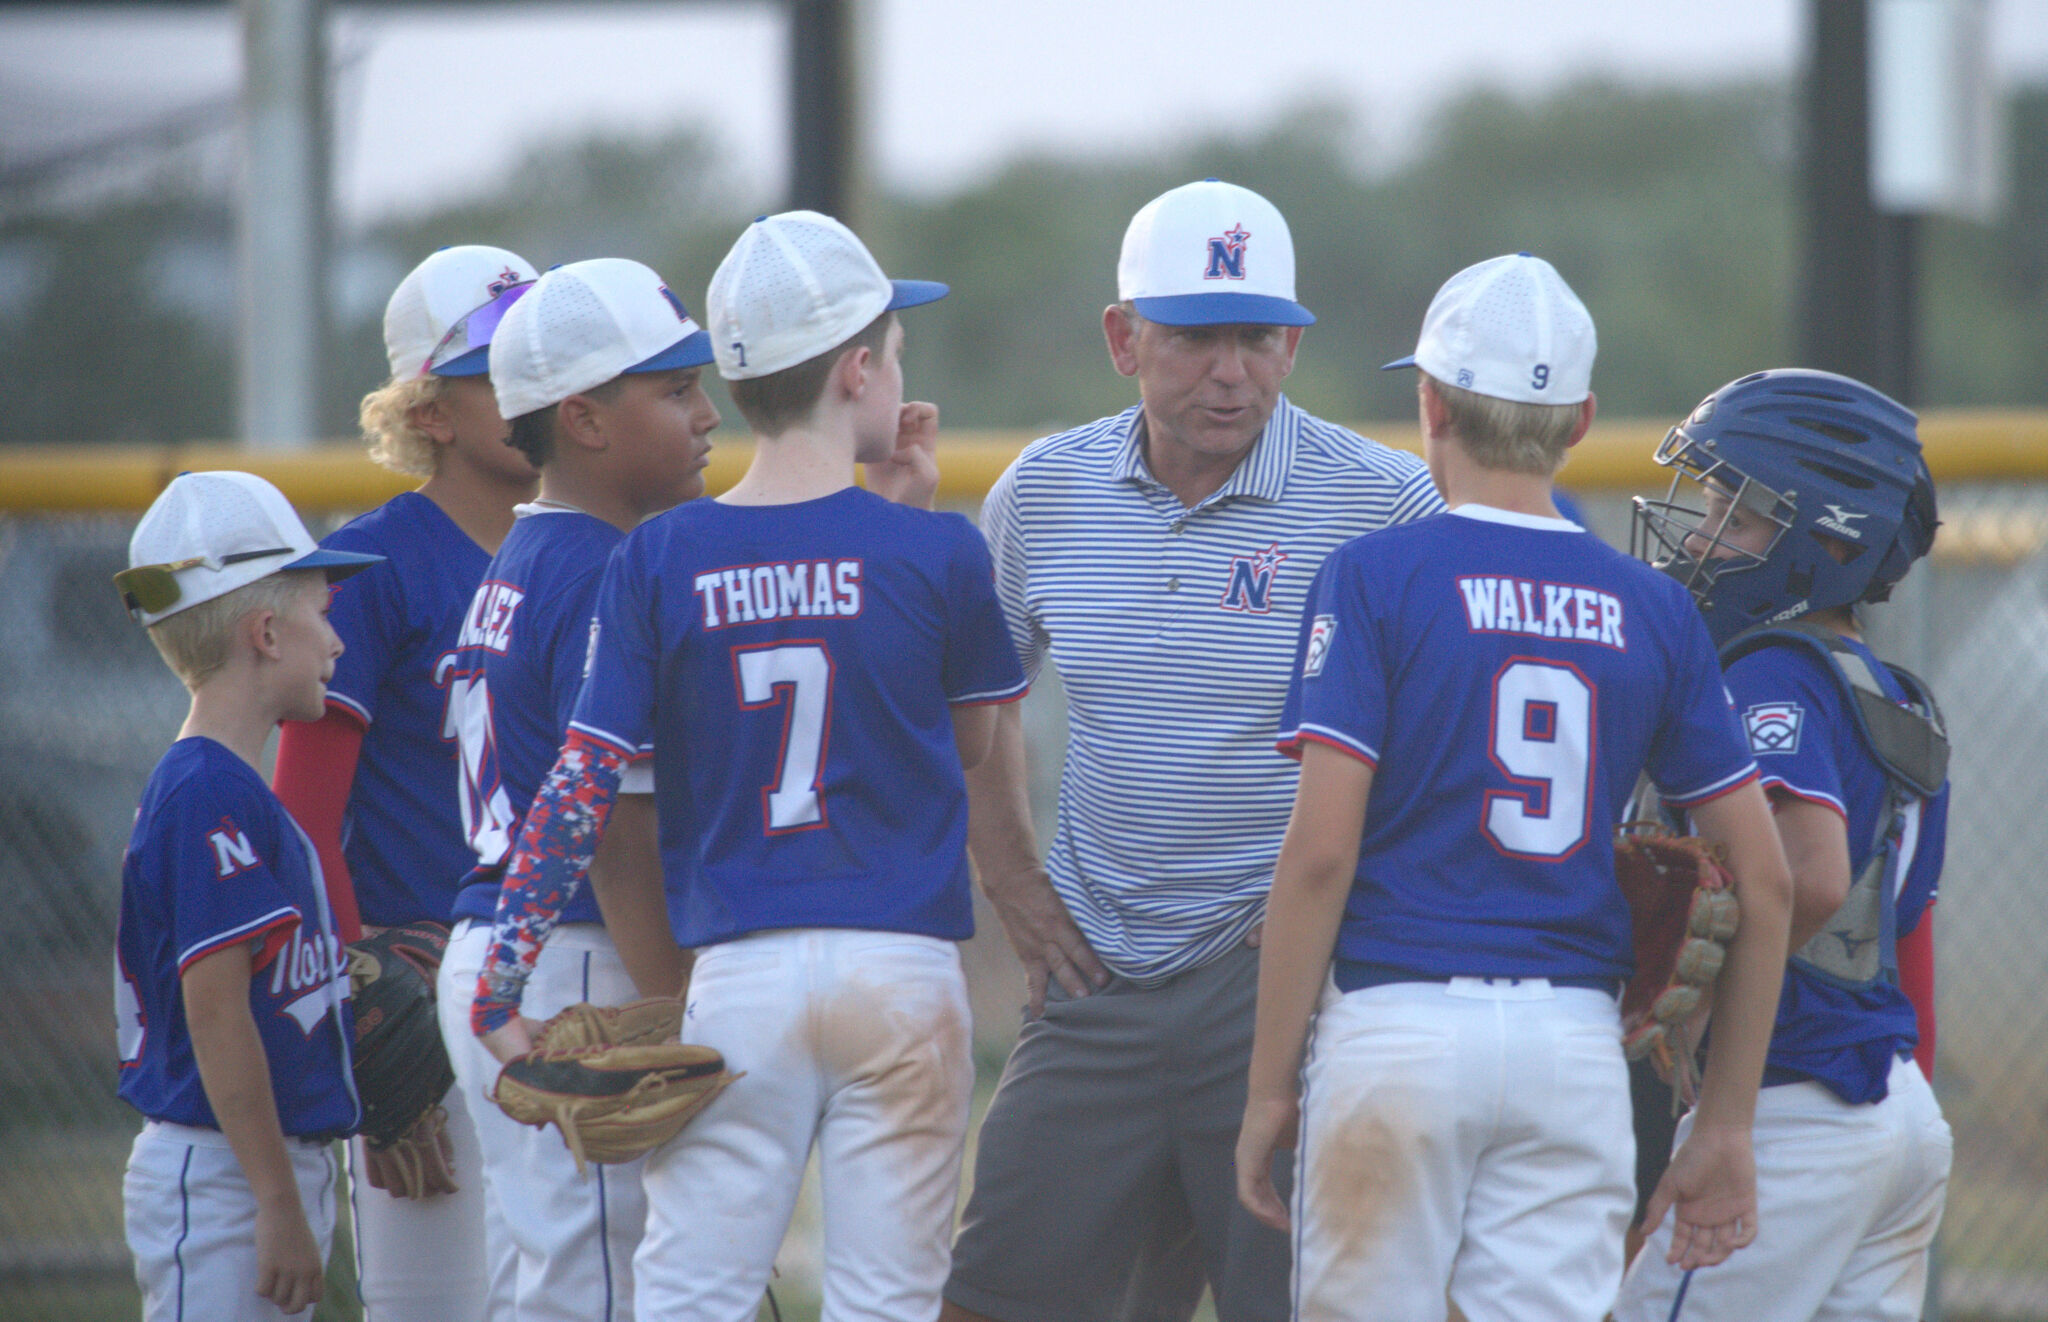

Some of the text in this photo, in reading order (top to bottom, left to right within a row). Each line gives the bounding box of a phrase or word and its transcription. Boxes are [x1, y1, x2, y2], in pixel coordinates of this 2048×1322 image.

[1204, 237, 1246, 280] N
[1531, 363, 1550, 391] 9
[694, 559, 863, 631] THOMAS
[1220, 555, 1275, 615] N
[1456, 575, 1626, 652] WALKER
[732, 640, 835, 835] 7
[1481, 656, 1597, 862] 9
[206, 826, 262, 882] N
